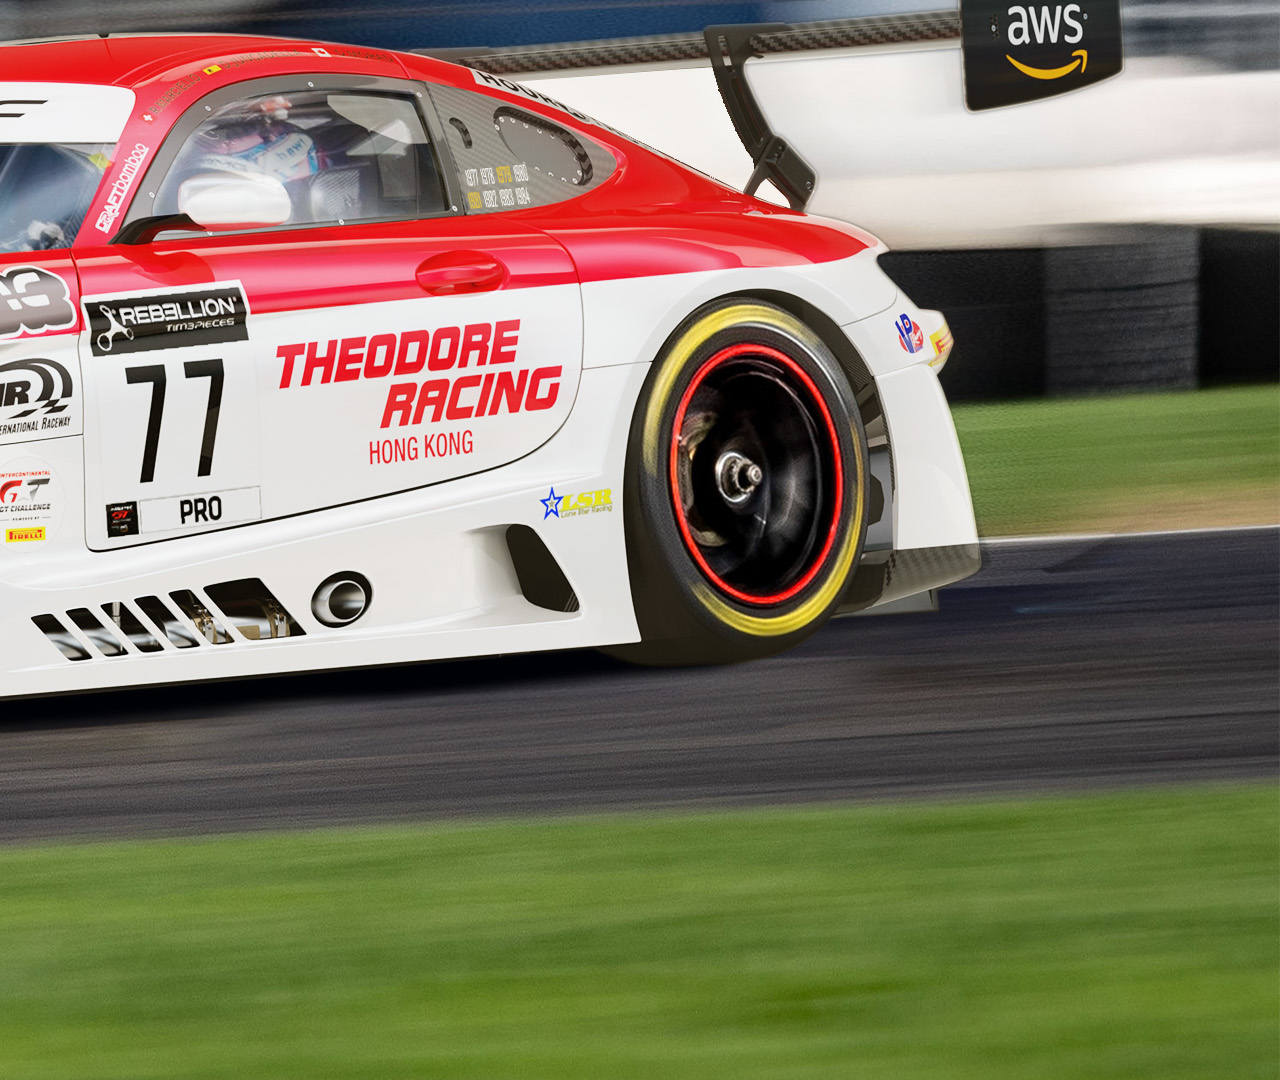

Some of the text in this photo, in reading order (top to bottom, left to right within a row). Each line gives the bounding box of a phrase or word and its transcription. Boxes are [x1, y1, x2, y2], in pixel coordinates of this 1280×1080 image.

[1007, 3, 1083, 45] aws
[276, 319, 521, 389] THEODORE
[380, 365, 563, 428] RACING
[42, 416, 71, 430] RACEWAY
[126, 358, 224, 483] 77
[369, 430, 474, 465] HONG KONG
[0, 470, 51, 478] INTERCONTINENTAL
[10, 503, 51, 512] CHALLENGE
[180, 496, 222, 524] PRO
[559, 488, 613, 512] LSR
[9, 529, 42, 540] PIRELLI
